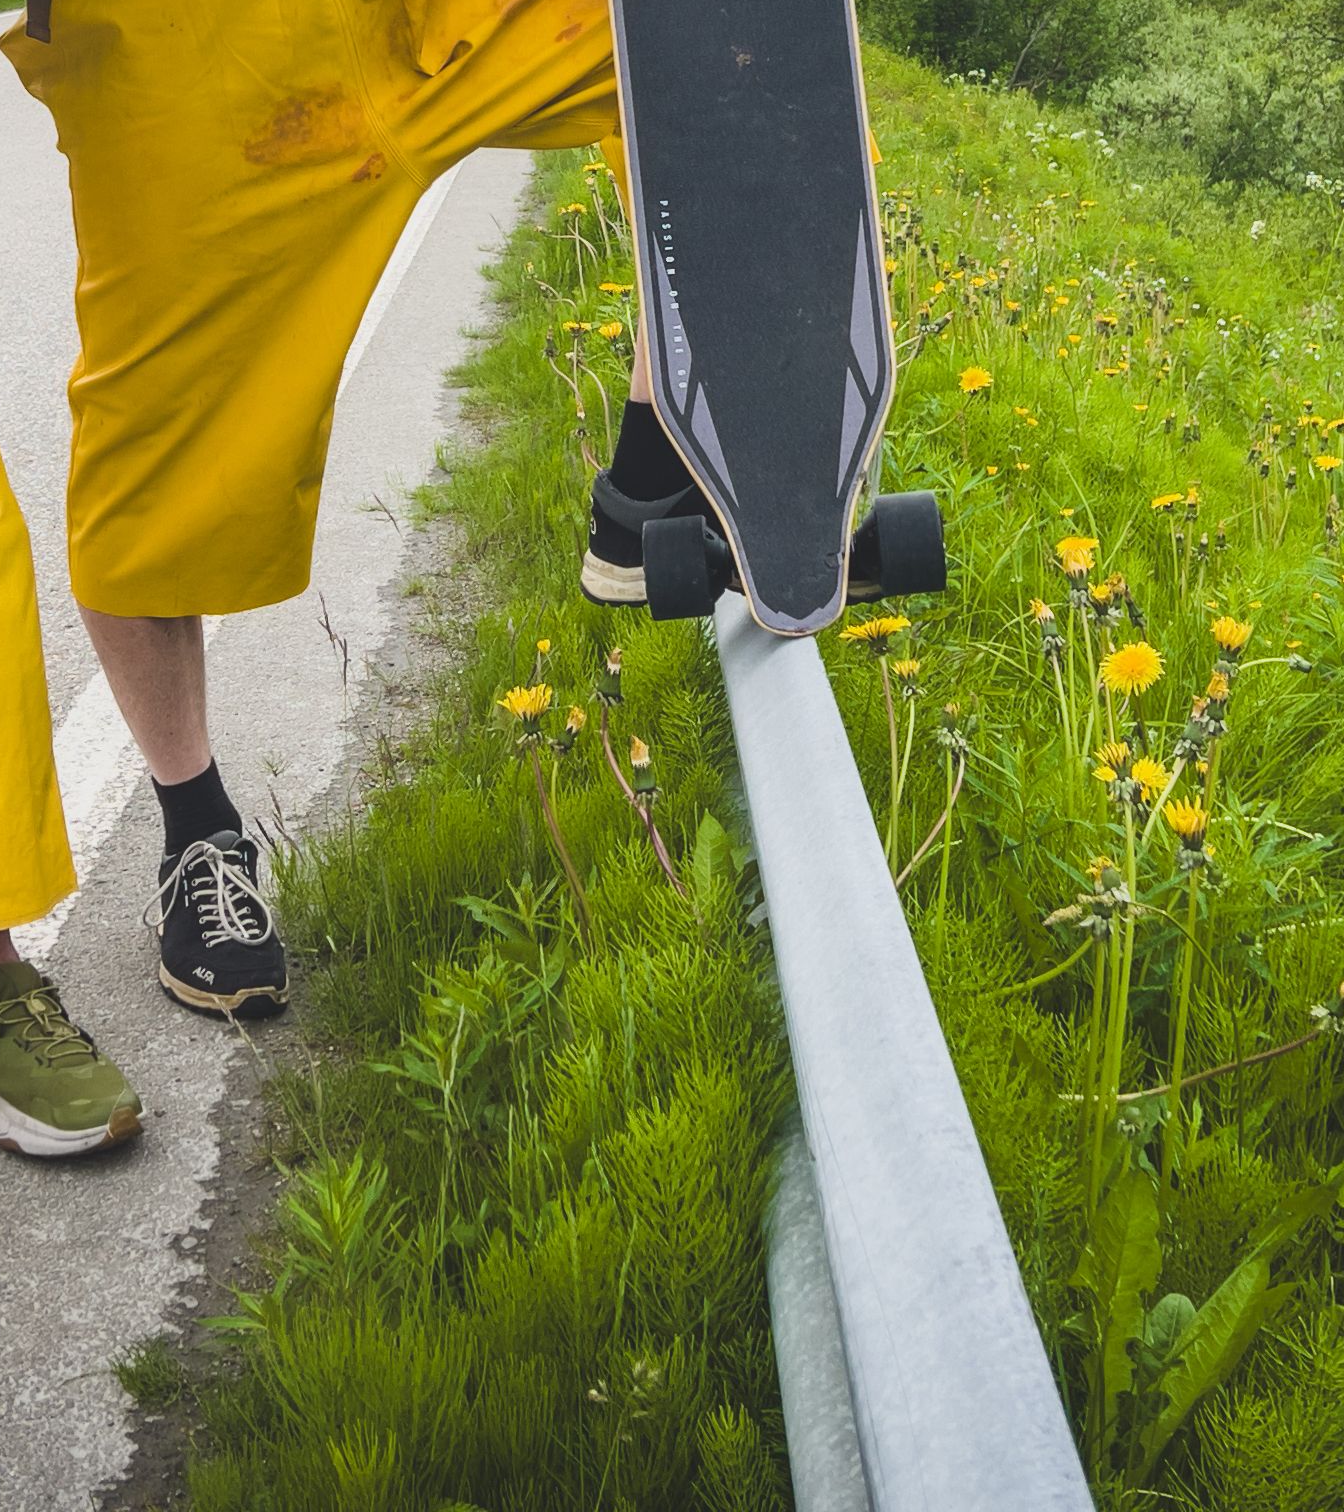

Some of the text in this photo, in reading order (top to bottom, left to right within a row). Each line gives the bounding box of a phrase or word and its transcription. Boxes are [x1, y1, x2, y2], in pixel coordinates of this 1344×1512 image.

[659, 199, 688, 389] PASSION ON THE GO
[192, 966, 215, 986] ALFA
